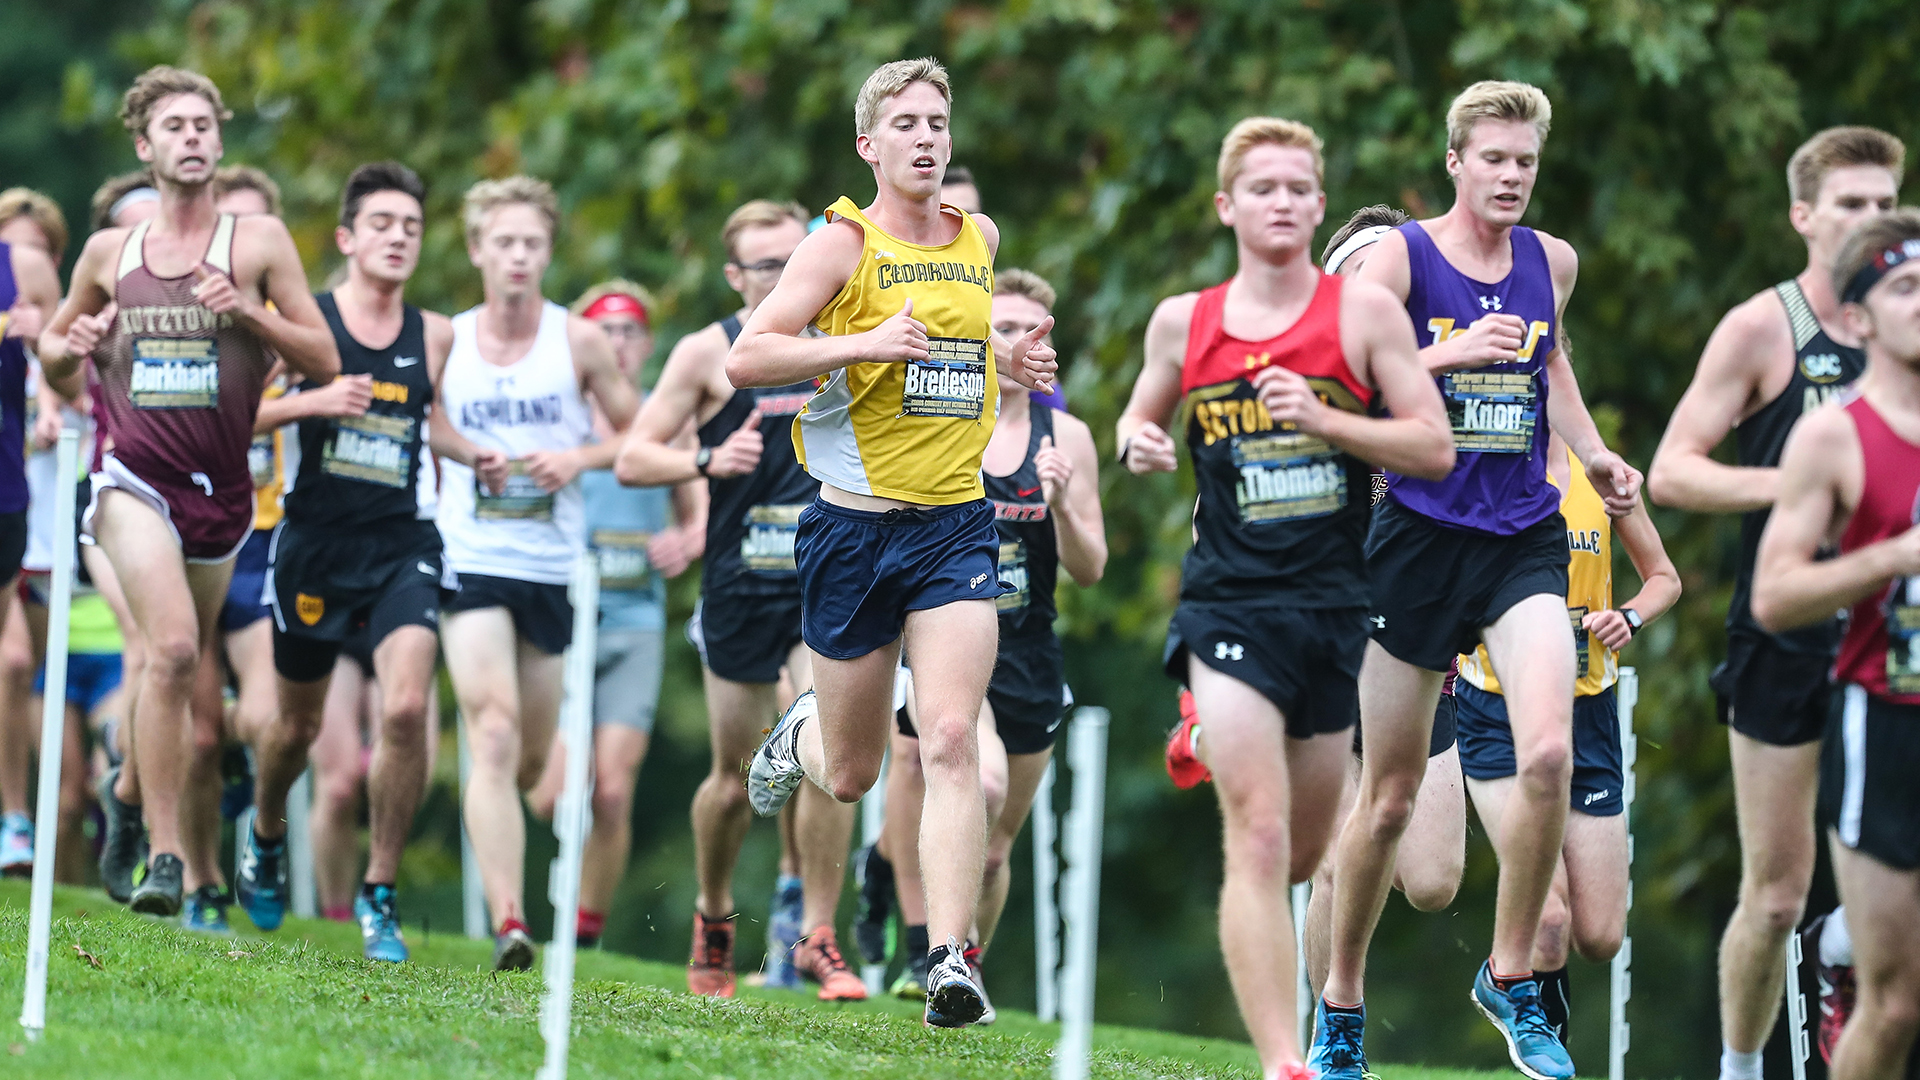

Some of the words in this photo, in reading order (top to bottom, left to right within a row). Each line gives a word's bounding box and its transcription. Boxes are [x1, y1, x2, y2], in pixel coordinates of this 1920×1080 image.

[877, 262, 990, 293] CEDARVILLE
[131, 361, 219, 392] Burkhart
[905, 362, 984, 398] Bredeson
[1464, 398, 1523, 430] Knorr
[1241, 461, 1340, 501] Thomas
[995, 502, 1048, 521] ERTS
[1567, 530, 1601, 555] LLE
